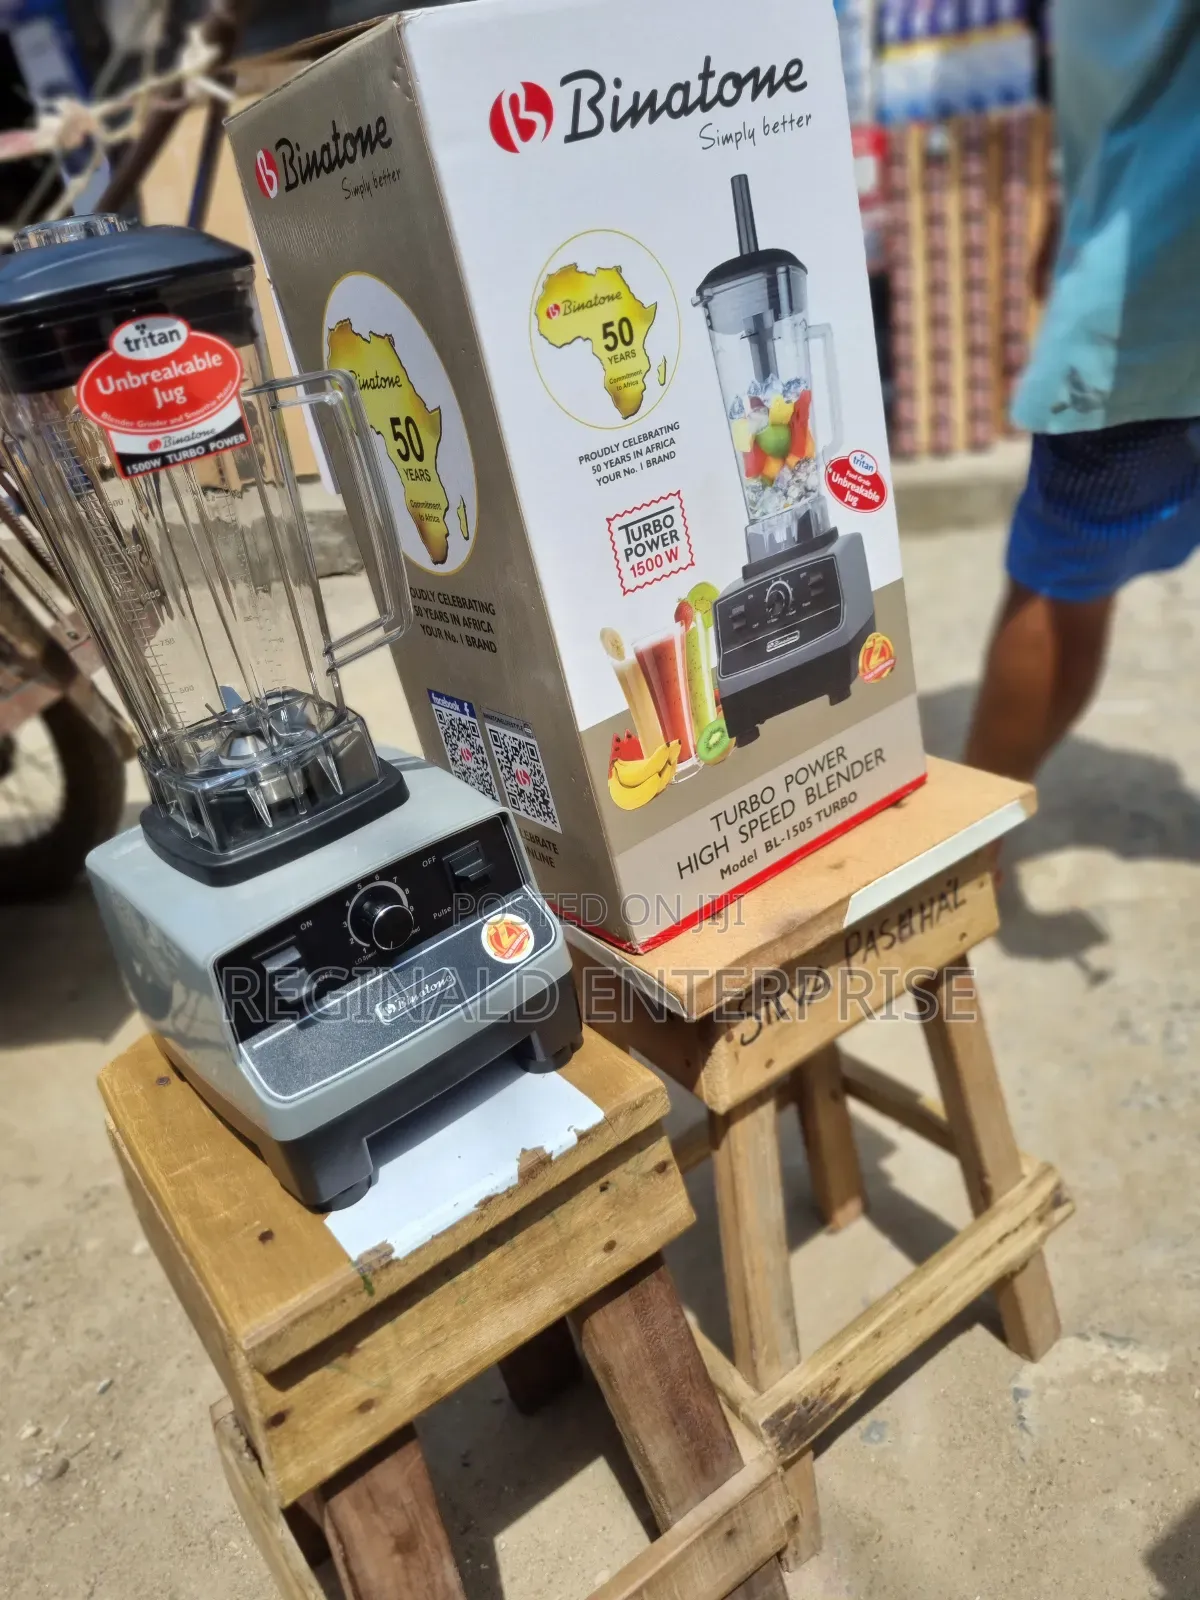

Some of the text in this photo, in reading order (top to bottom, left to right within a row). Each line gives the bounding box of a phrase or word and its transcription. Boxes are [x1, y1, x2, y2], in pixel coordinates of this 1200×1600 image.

[559, 55, 808, 144] Binatone
[699, 112, 812, 150] Simply better
[275, 116, 393, 193] Binatone
[341, 167, 401, 200] Simply better
[561, 291, 623, 316] Binatone
[123, 326, 182, 353] tritan
[602, 316, 634, 352] 50
[607, 349, 637, 365] YEARS
[96, 351, 223, 396] Unbreakable
[608, 369, 643, 385] Commitment
[622, 379, 639, 389] Africa
[153, 385, 187, 409] Jug
[161, 428, 216, 449] Binatone
[390, 415, 425, 462] 50
[578, 421, 680, 465] PROUDLY CELEBRATING
[126, 433, 248, 476] 1500W TURBO POWER
[591, 437, 676, 474] 50 YEARS IN AFRICA
[596, 470, 622, 486] YOUR
[623, 467, 638, 477] No.
[646, 450, 676, 468] BRAND
[852, 455, 874, 472] tritan
[403, 468, 431, 482] YEARS
[831, 471, 880, 503] Unbreakable
[844, 490, 859, 507] Jug
[618, 505, 675, 545] TURBO
[624, 529, 680, 562] POWER
[630, 546, 679, 578] 1500 W
[410, 587, 496, 616] OUDLY CELEBRATING
[413, 605, 495, 634] 50 YEARS IN AFRICA
[420, 624, 444, 640] YOUR
[467, 635, 497, 653] BRAND
[710, 746, 848, 832] TURBO POWER
[677, 748, 886, 879] HIGH SPEED BLENDER
[519, 828, 559, 855] LEBRATE
[720, 791, 858, 879] Model BL-1505 TURBO
[422, 856, 437, 868] OFF
[525, 845, 555, 868] NLINE
[301, 920, 313, 931] ON
[432, 906, 452, 919] Pulse
[349, 937, 355, 945] 2
[318, 969, 333, 981] OFF
[395, 975, 454, 1011] Binatone
